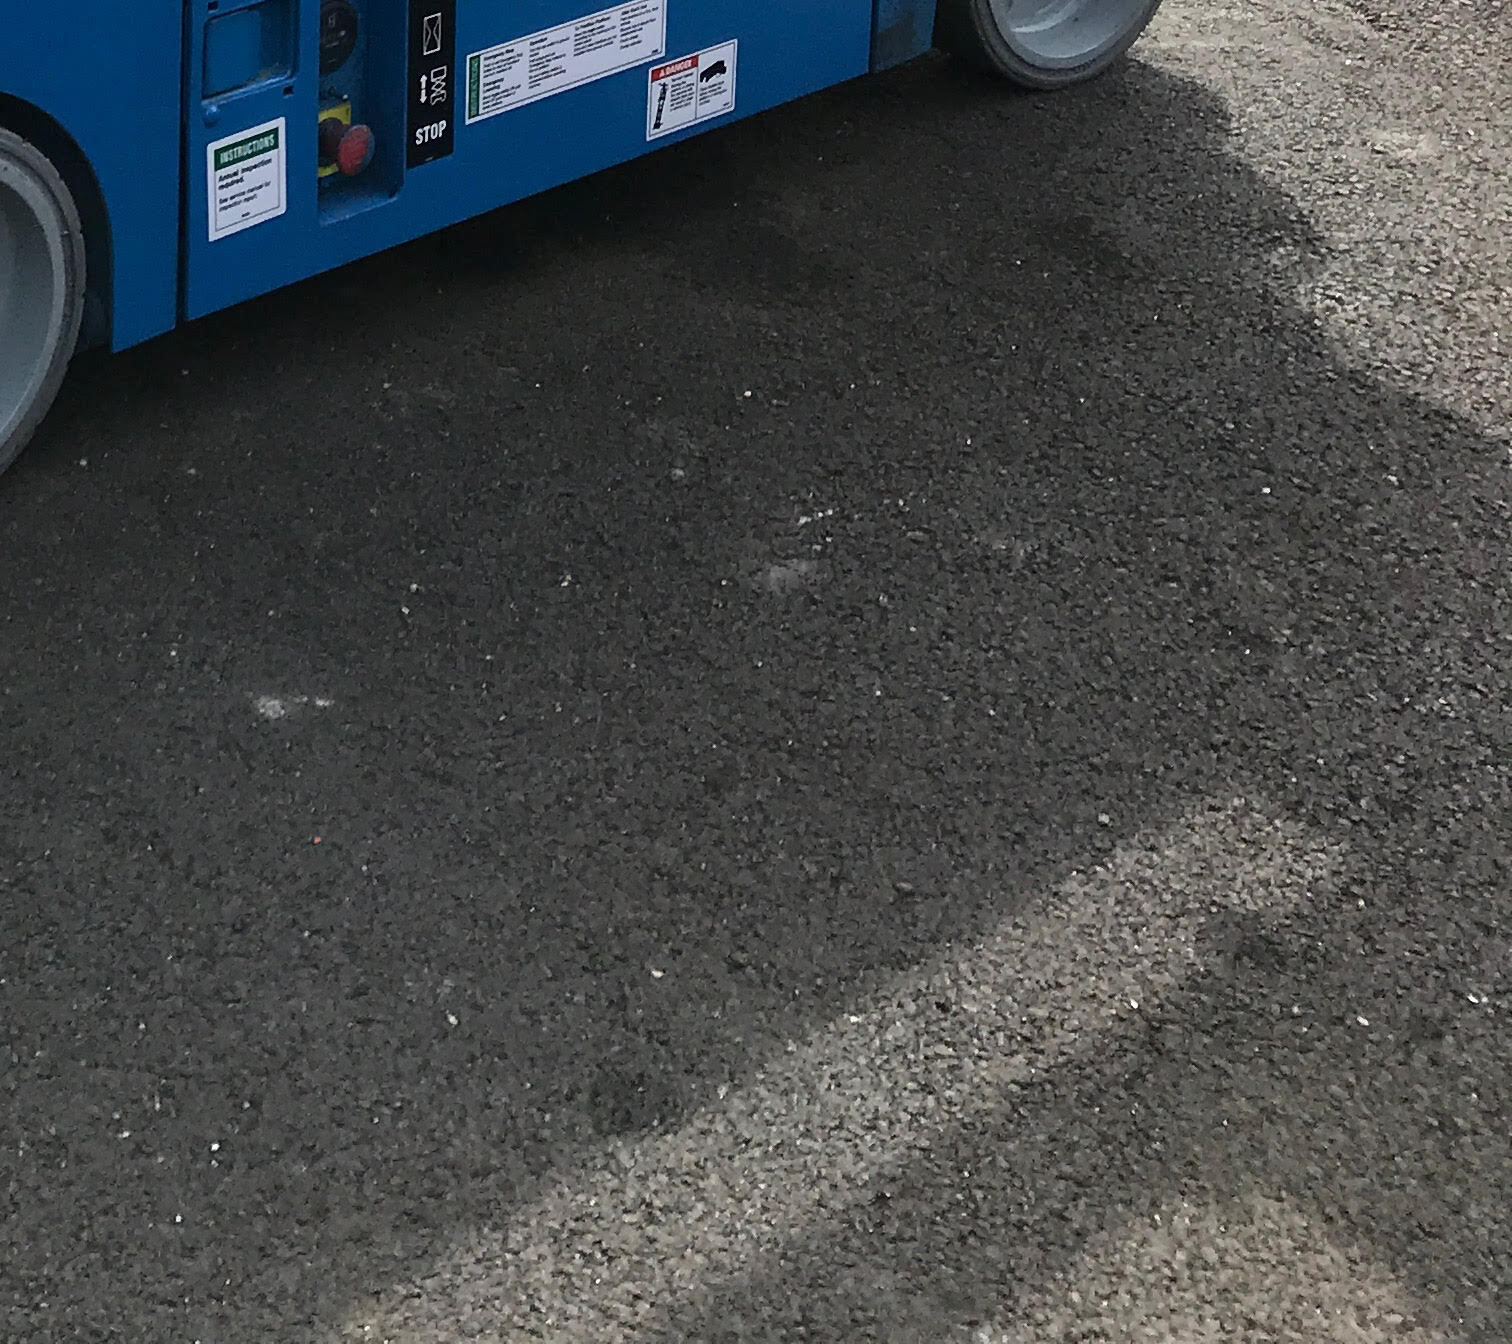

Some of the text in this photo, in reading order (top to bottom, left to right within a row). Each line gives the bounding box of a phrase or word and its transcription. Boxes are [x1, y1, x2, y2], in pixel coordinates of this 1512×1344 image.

[416, 119, 447, 145] STOP
[220, 133, 274, 165] INSTRUCTIONS
[218, 158, 271, 182] Annual inspection
